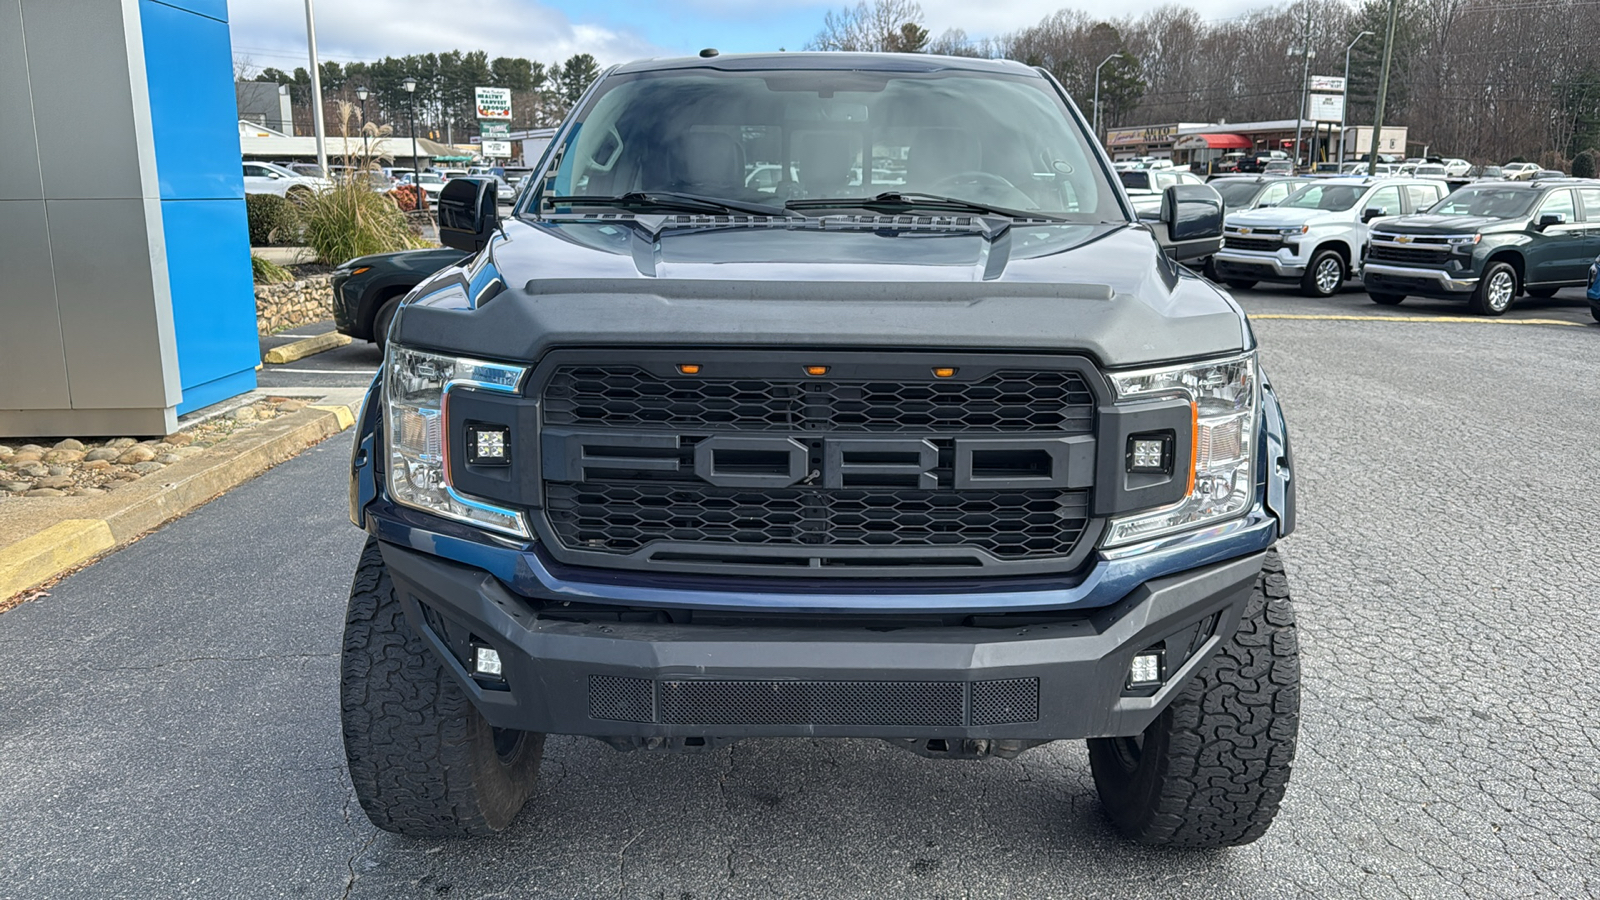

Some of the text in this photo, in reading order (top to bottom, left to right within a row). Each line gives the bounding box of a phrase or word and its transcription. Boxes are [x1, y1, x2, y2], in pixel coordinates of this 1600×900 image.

[1144, 127, 1170, 135] AUTO
[1143, 134, 1169, 142] MART
[542, 431, 1095, 490] FORD
